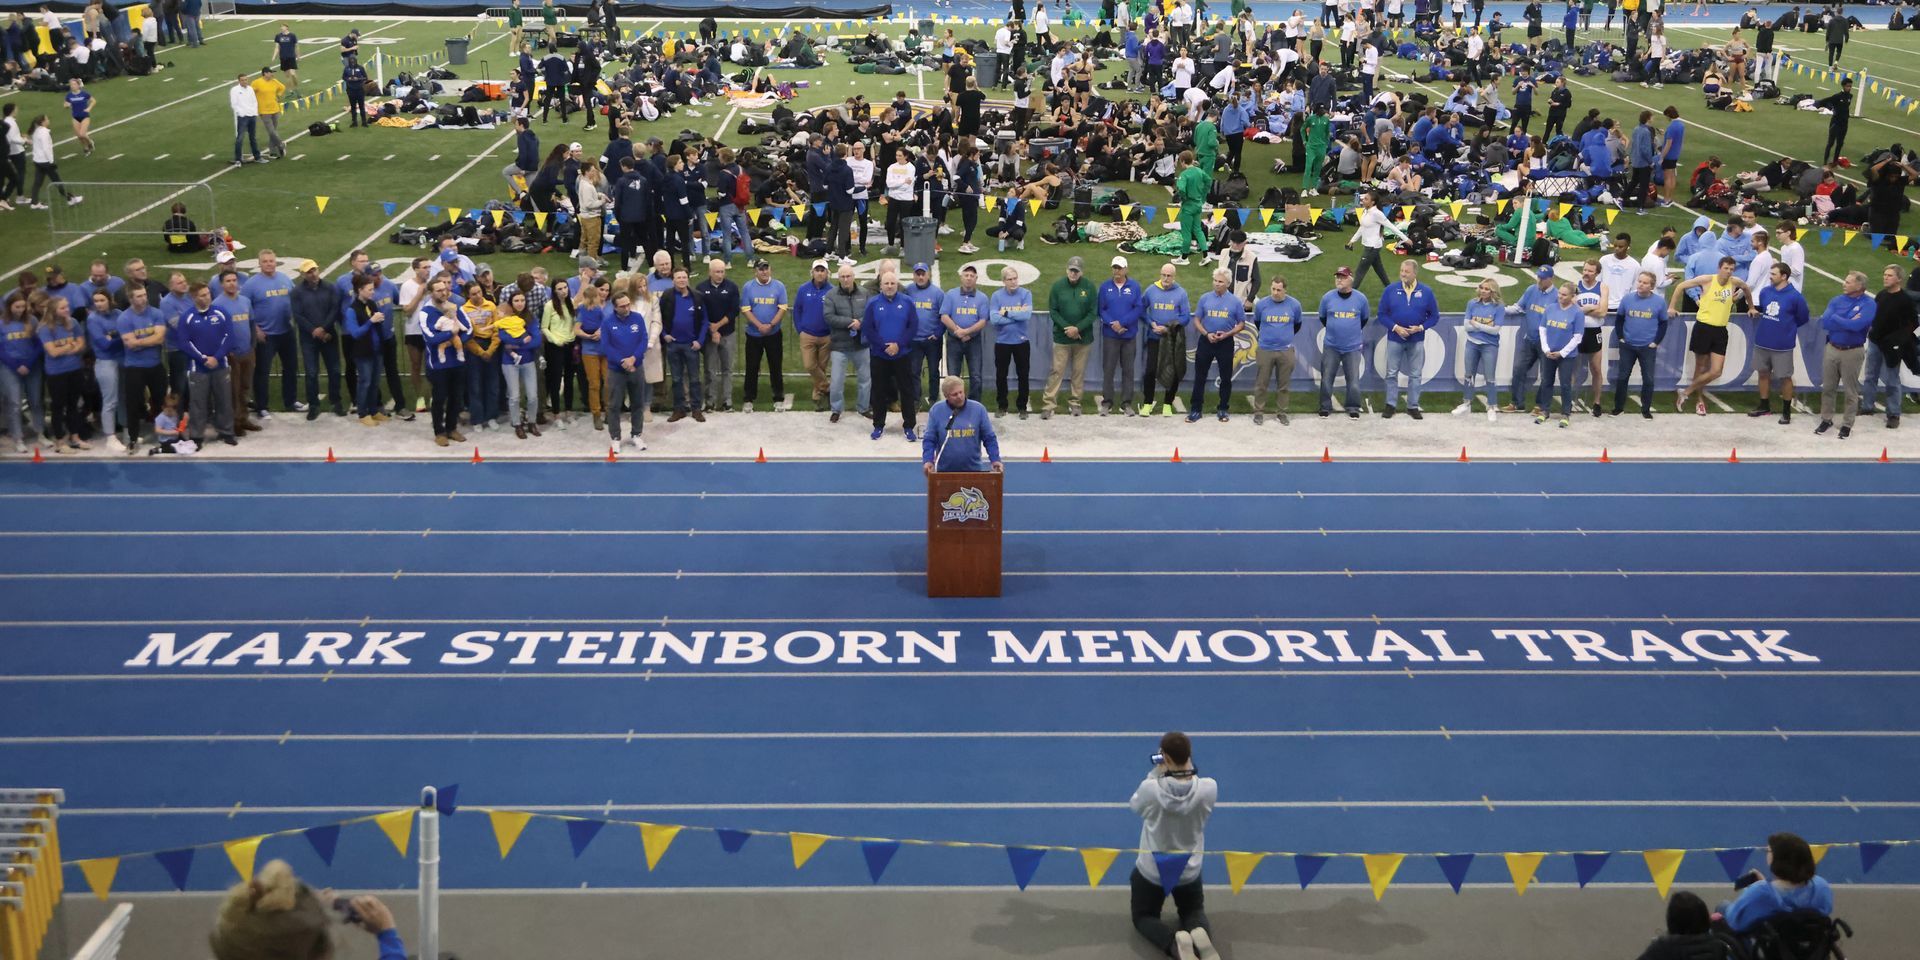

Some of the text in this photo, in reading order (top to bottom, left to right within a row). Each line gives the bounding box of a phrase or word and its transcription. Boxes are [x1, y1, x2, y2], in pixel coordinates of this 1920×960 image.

[125, 630, 1820, 665] MARK STEINBORN MEMORIAL TRACK
